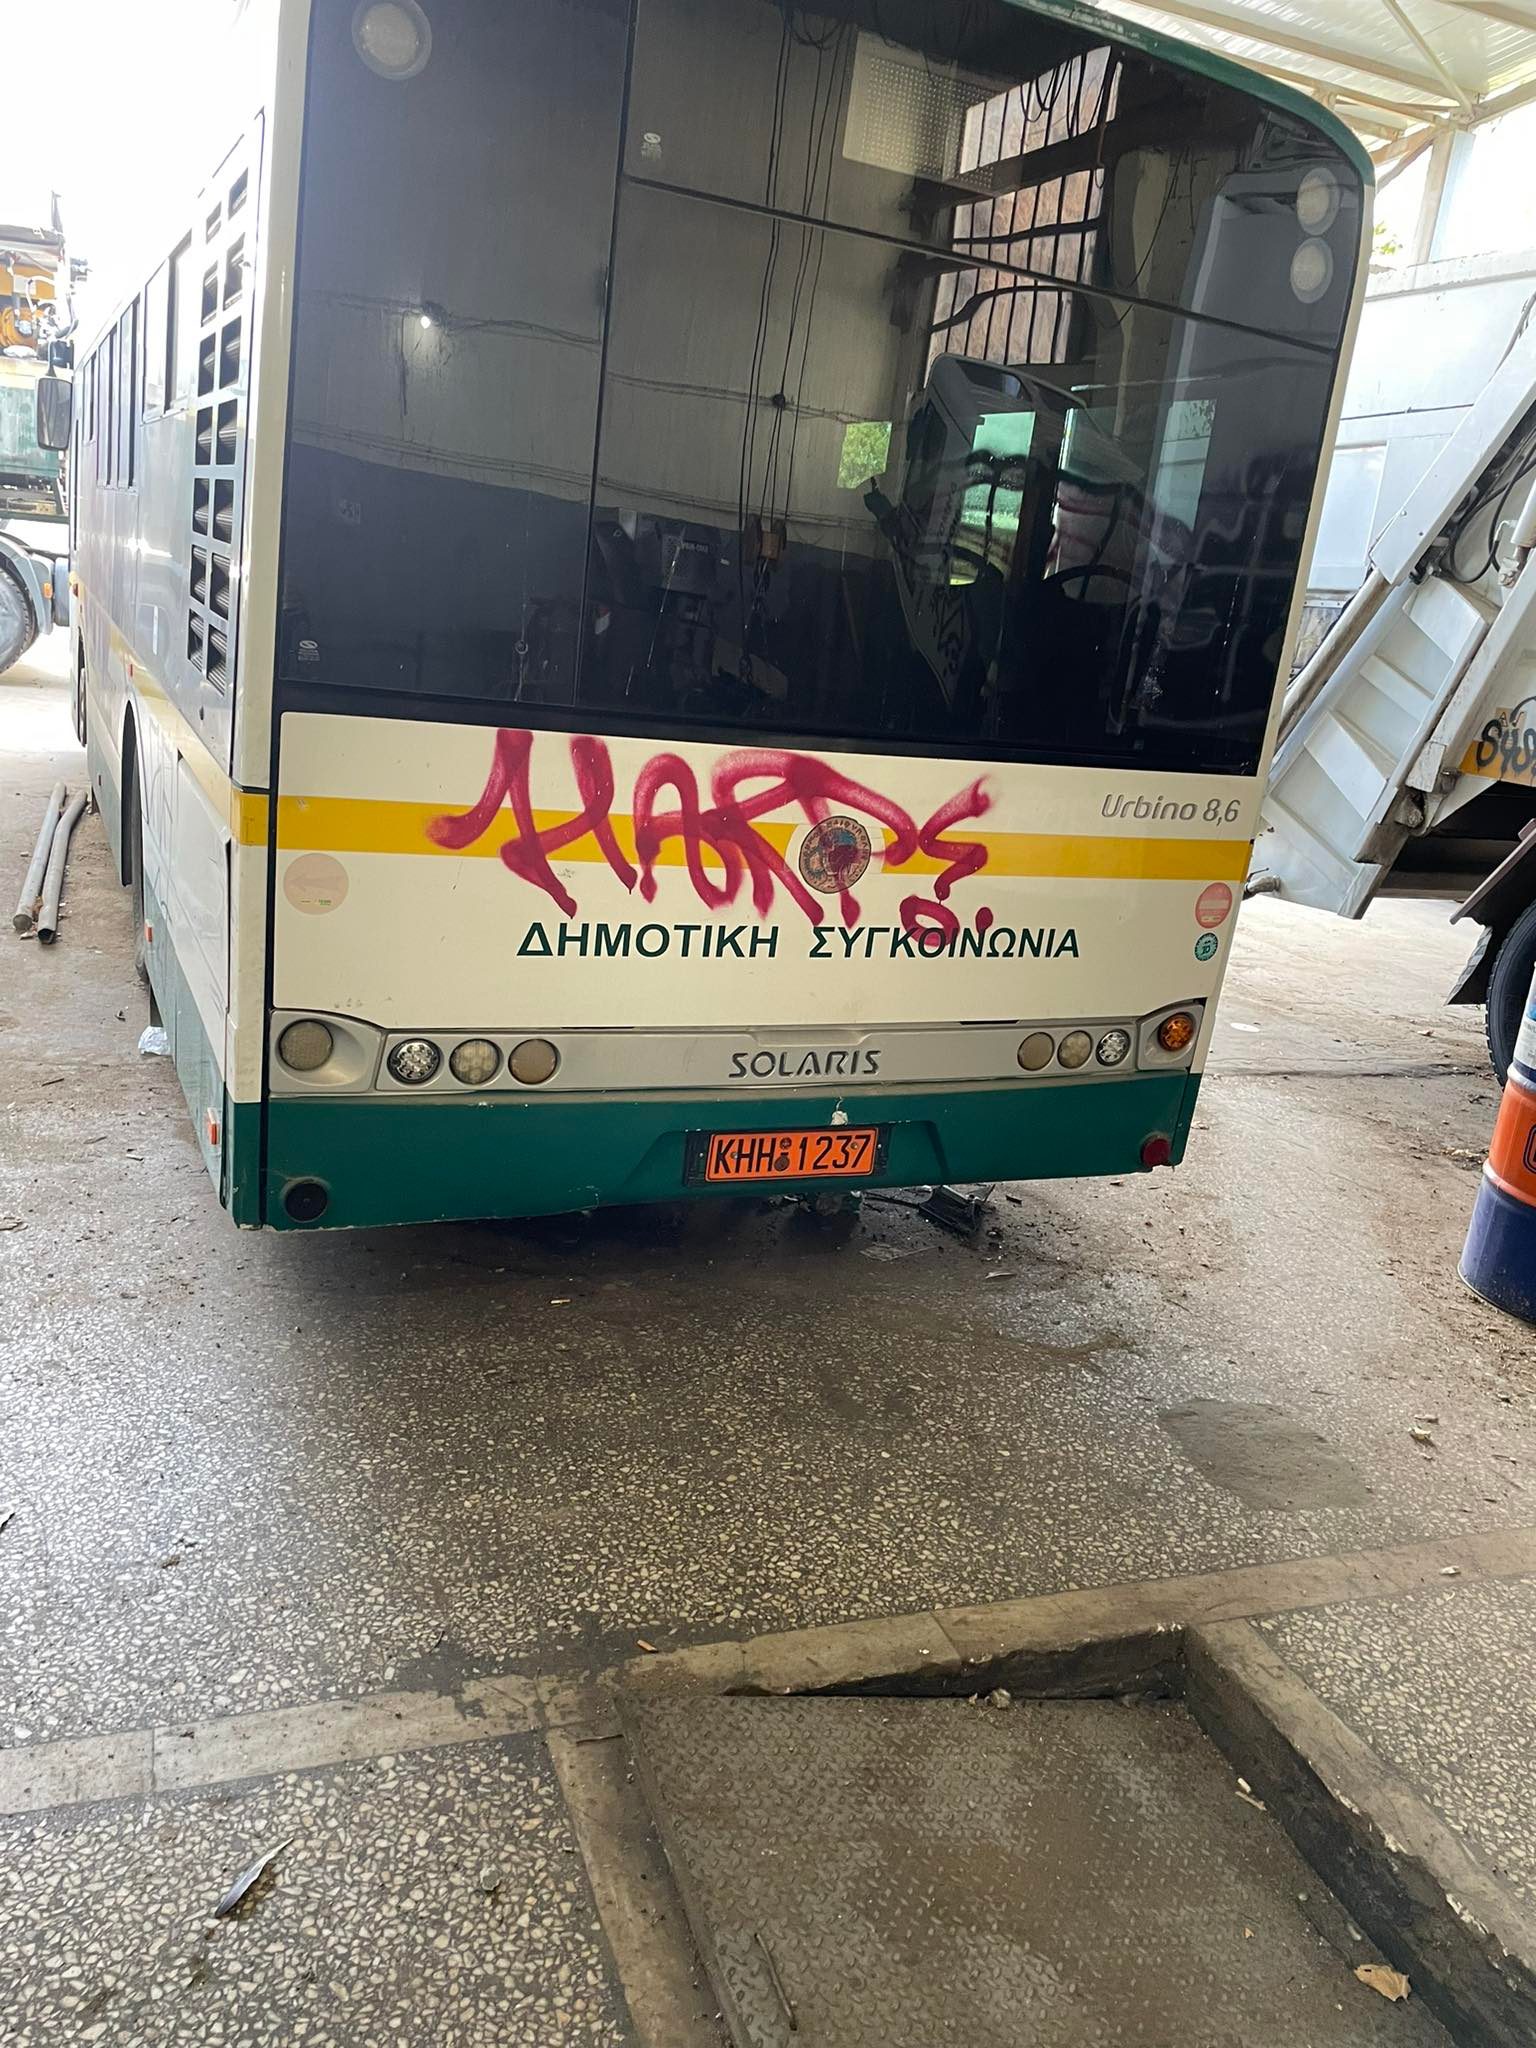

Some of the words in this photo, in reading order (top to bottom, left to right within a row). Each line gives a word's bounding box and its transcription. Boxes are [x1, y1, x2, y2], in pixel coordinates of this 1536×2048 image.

[1101, 793, 1199, 821] Urbino
[1202, 798, 1241, 826] 8,6
[516, 922, 780, 959] ΔΗΜΟΤΙΚΗ
[808, 926, 1081, 959] ΣΥΓΚΟΙΝΩΝΙΑ
[728, 1050, 882, 1079] SOLARIS
[798, 1133, 872, 1171] 1237
